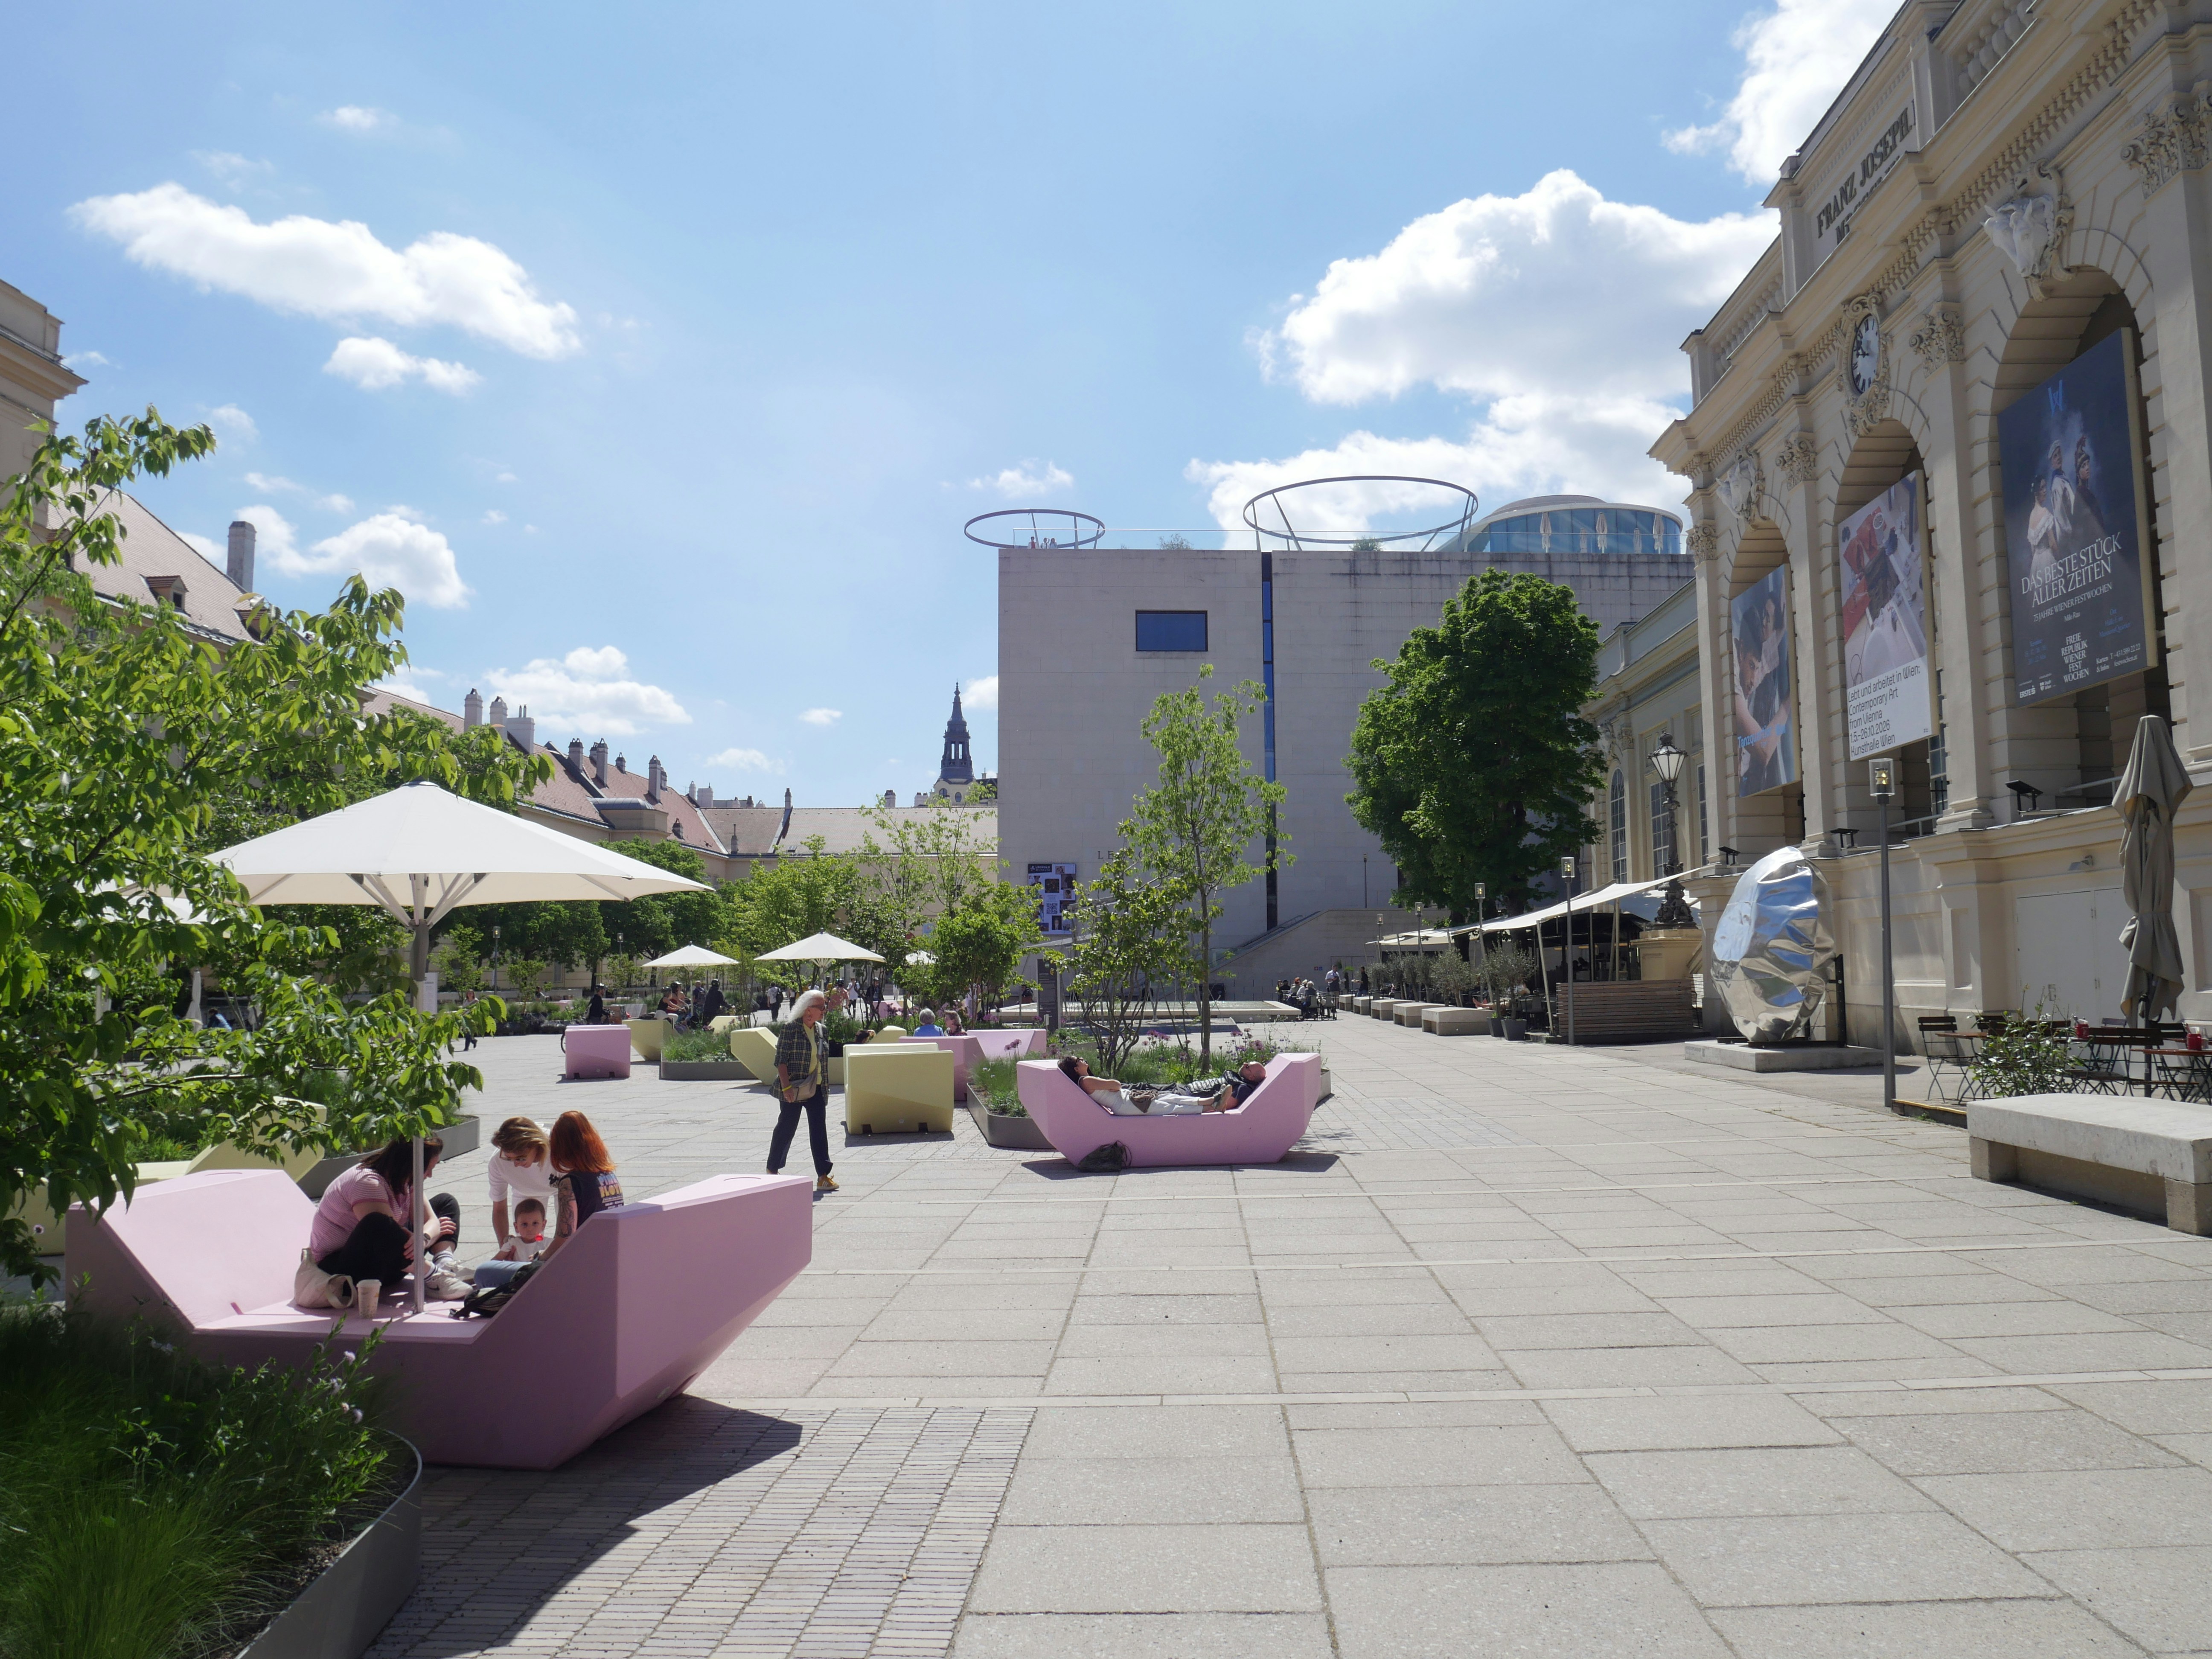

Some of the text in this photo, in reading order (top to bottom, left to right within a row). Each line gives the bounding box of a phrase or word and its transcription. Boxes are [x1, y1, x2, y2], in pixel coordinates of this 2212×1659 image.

[1816, 172, 1857, 239] FRANZ
[2021, 532, 2122, 594] DAS BESTE STÜCK
[2032, 556, 2112, 608] ALLER ZEITEN
[2054, 598, 2074, 613] WIENER
[2074, 582, 2112, 604] FESTWOCHEN
[2061, 639, 2088, 656] REPUBLIK
[2066, 632, 2081, 645] FREIE
[2064, 650, 2086, 664] WIENER
[2069, 661, 2082, 672] FEST
[1848, 665, 1920, 703] Lebt und arbeitet in Wien:
[2063, 668, 2089, 683] WOCHEN
[1849, 687, 1898, 716] Contemporary Art
[1849, 709, 1883, 730] from Vienna
[1851, 734, 1895, 757] Kunsthalle Wien
